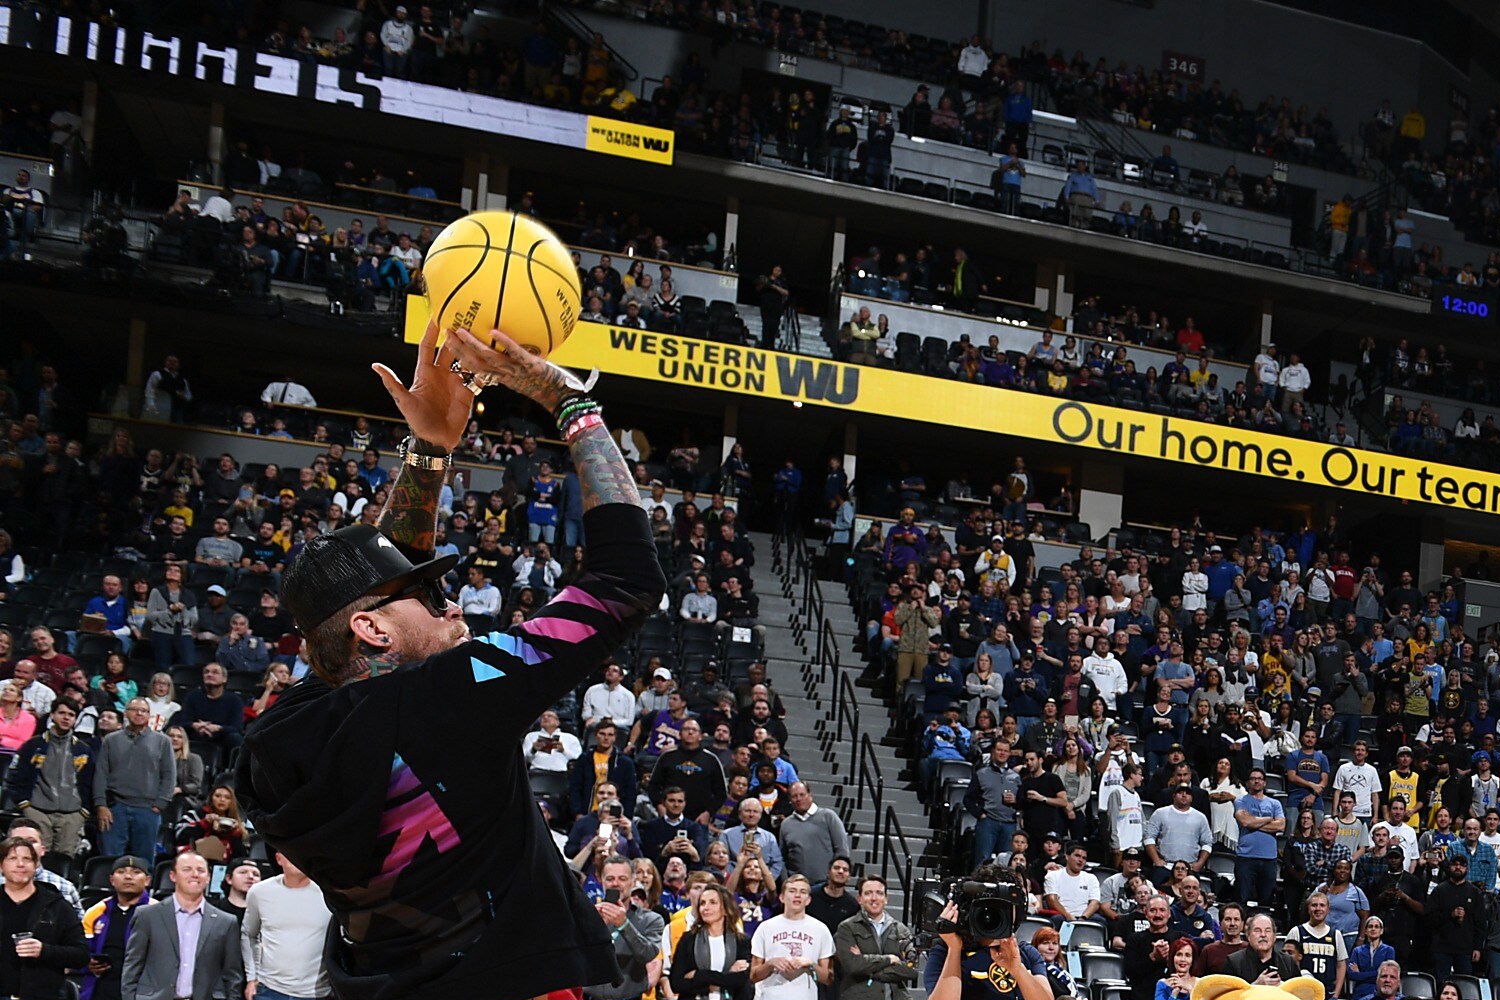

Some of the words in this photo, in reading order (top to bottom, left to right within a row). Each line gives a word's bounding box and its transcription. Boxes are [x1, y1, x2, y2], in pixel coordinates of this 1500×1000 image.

[1168, 57, 1198, 75] 346
[592, 127, 640, 142] WESTERN
[606, 134, 640, 148] UNION
[642, 136, 670, 153] WU
[1442, 295, 1489, 317] 12:00
[609, 329, 766, 371] WESTERN
[658, 359, 765, 392] UNION
[775, 355, 860, 405] WU
[1053, 401, 1145, 452] Our
[1160, 417, 1305, 480] home.
[1321, 447, 1405, 495] Our
[742, 905, 763, 922] 24
[772, 931, 814, 945] MID-CAPE
[1312, 957, 1327, 974] 15
